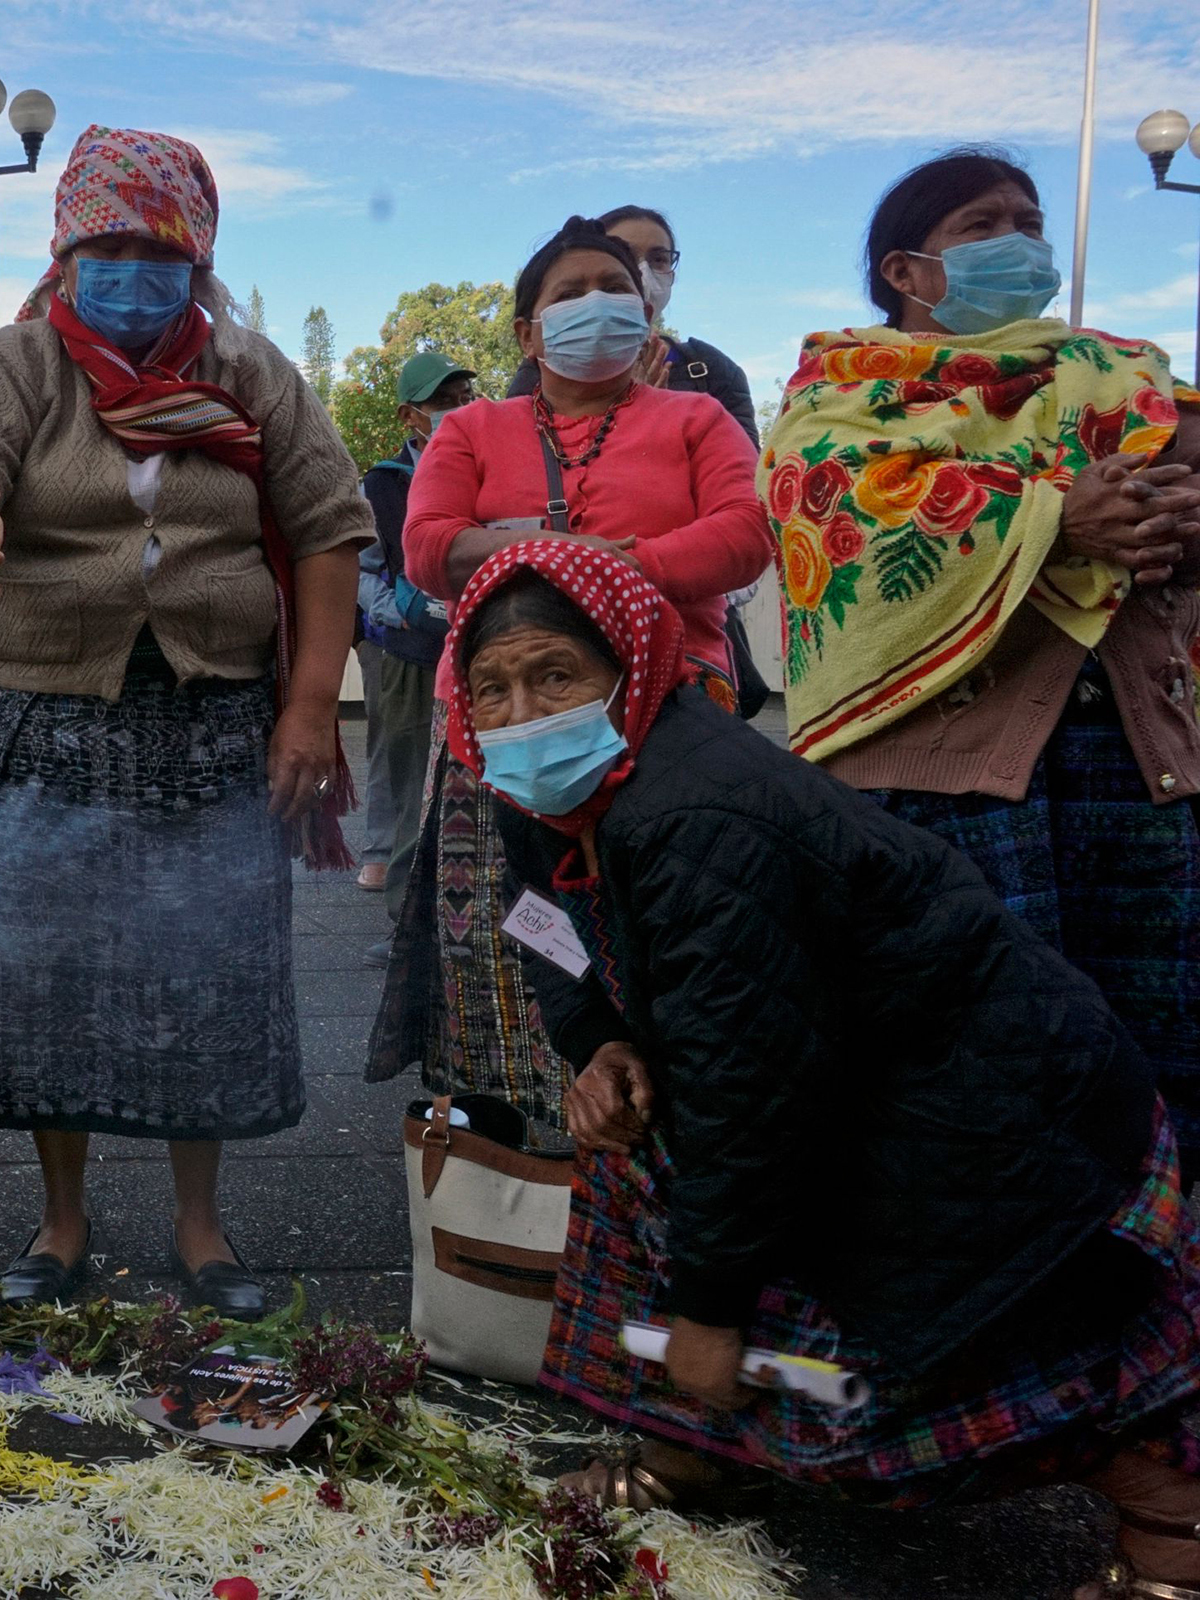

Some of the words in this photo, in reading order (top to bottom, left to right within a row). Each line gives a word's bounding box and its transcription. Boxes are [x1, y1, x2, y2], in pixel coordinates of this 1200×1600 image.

[525, 901, 552, 920] Mujeres
[515, 908, 547, 931] Achi
[228, 1364, 275, 1375] JUSTICIA
[214, 1372, 253, 1384] Mujeres
[252, 1376, 268, 1385] las
[269, 1379, 283, 1387] de
